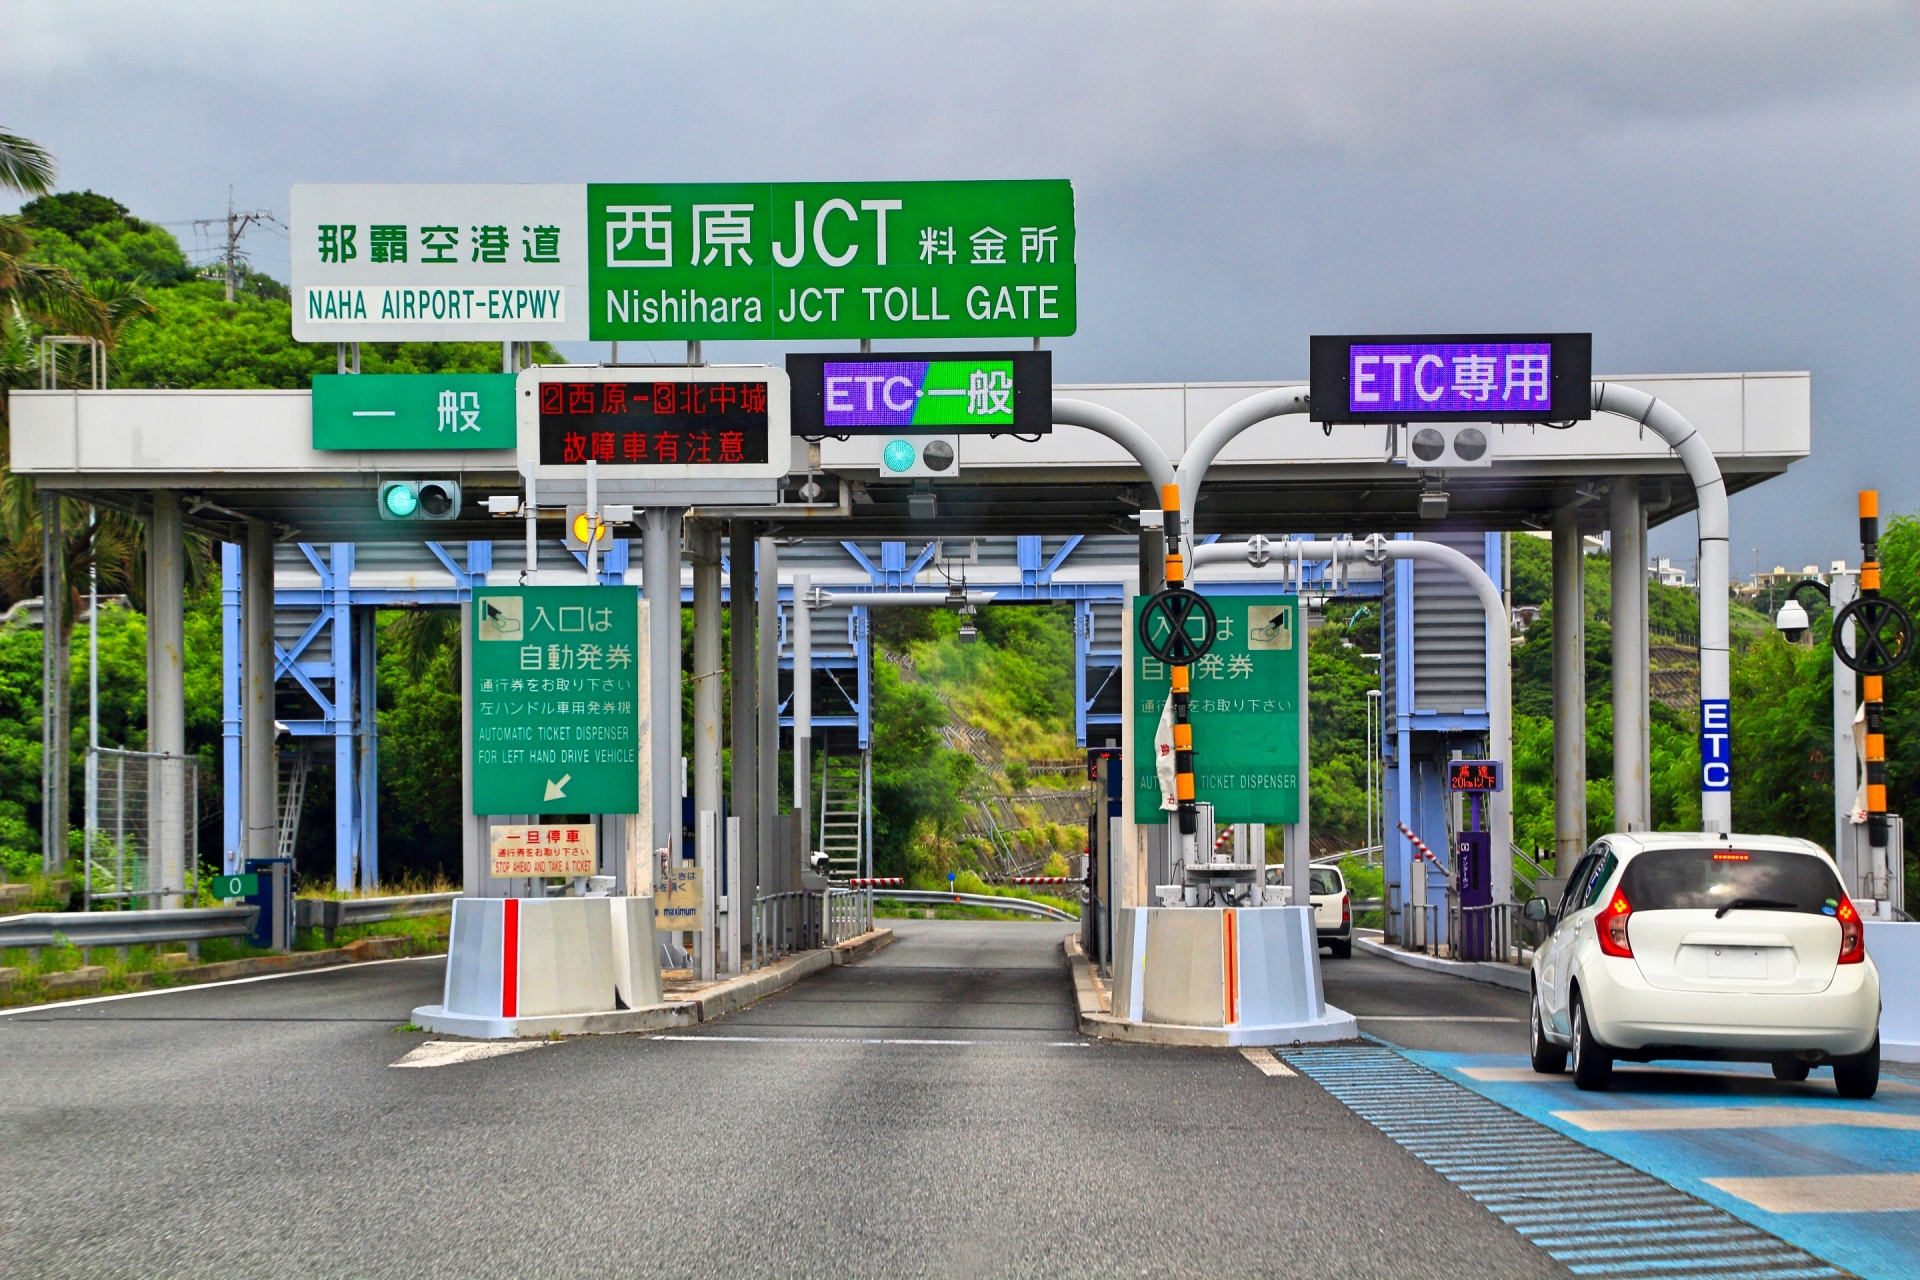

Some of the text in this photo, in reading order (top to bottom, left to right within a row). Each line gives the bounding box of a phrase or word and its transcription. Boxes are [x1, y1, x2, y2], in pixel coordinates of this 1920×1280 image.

[318, 224, 561, 264] 那覇空港道
[772, 198, 903, 268] JCT
[918, 225, 1059, 265] 料金所
[308, 288, 561, 320] NAHA AIRPORT-EXPWY
[606, 285, 1059, 323] Nishihara JCT TOLL GATE
[1354, 353, 1549, 403] ETC専用
[352, 390, 482, 432] 一般
[563, 431, 744, 463] 故障車有注意
[529, 606, 613, 632] 入口は
[520, 643, 632, 670] 自動発券
[1141, 653, 1254, 680] 自発券
[480, 678, 631, 693] 通行券をお取り下さい
[480, 701, 631, 715] 左ハンドル車用発券機
[479, 726, 629, 741] AUTOMATIC TICKET DISPENSER
[1703, 703, 1729, 787] ETC
[478, 748, 635, 764] FOR LEFT HAND DRIVE VEHICLE
[1201, 774, 1296, 789] TICKET DISPENSER
[507, 830, 580, 844] 一旦停車
[497, 847, 589, 857] 通行券をお取り下さい
[495, 860, 591, 873] STOP AHEAD AND TAKE A TICKET
[229, 877, 242, 895] 0
[664, 906, 696, 916] maximum
